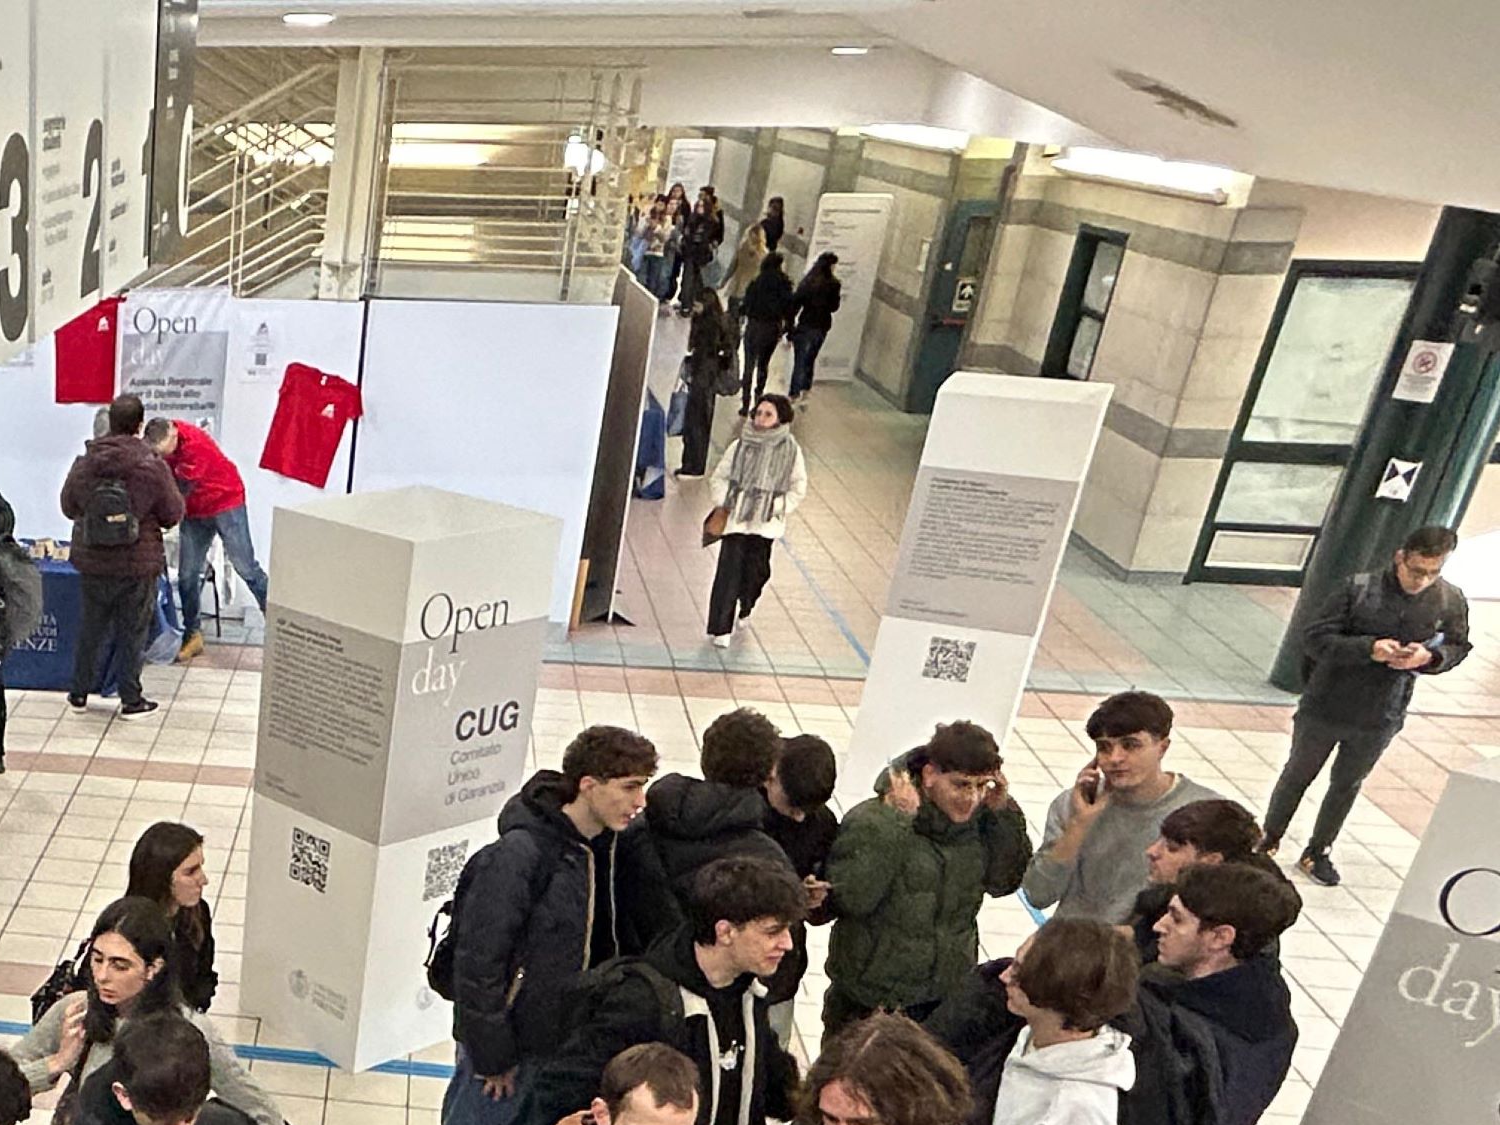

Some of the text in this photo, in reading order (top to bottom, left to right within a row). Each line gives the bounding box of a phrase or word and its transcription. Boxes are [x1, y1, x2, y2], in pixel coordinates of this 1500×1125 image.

[80, 119, 102, 298] 2
[133, 307, 197, 345] Open
[420, 592, 510, 654] Open
[12, 637, 58, 652] ENZE
[411, 645, 468, 707] day
[455, 701, 519, 741] CUG
[450, 743, 502, 766] Comitato
[447, 768, 480, 786] Unico
